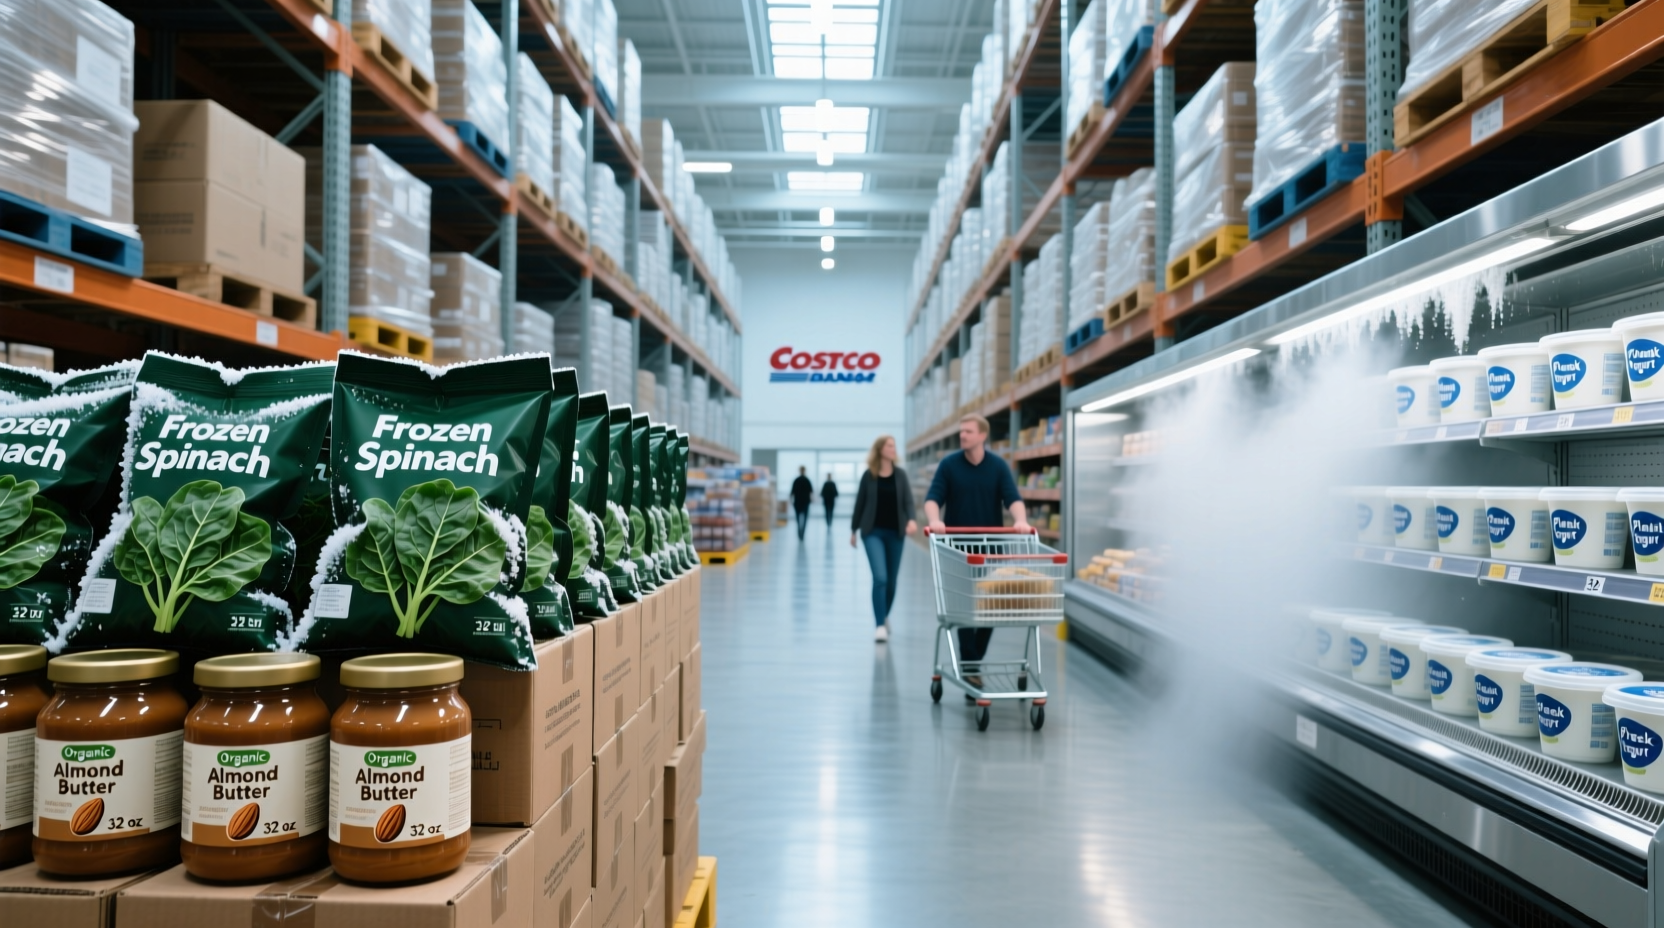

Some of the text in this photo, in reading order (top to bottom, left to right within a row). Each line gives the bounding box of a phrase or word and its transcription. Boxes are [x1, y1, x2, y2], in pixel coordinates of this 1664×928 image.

[159, 414, 270, 443] Frozen
[372, 414, 492, 442] Frozen
[135, 441, 270, 478] Spinach
[354, 441, 499, 478] Spinach
[64, 746, 110, 761] Organic
[220, 751, 267, 767] Organic
[367, 752, 413, 768] Organic
[54, 759, 124, 778] Almond
[208, 765, 279, 784] Almond
[355, 766, 425, 784] Almond
[58, 779, 117, 796] Butter
[213, 784, 271, 800] Butter
[360, 785, 418, 801] Butter
[107, 817, 143, 830] 32 oz
[263, 821, 297, 834] 32 oz
[410, 823, 442, 837] 32 oz
